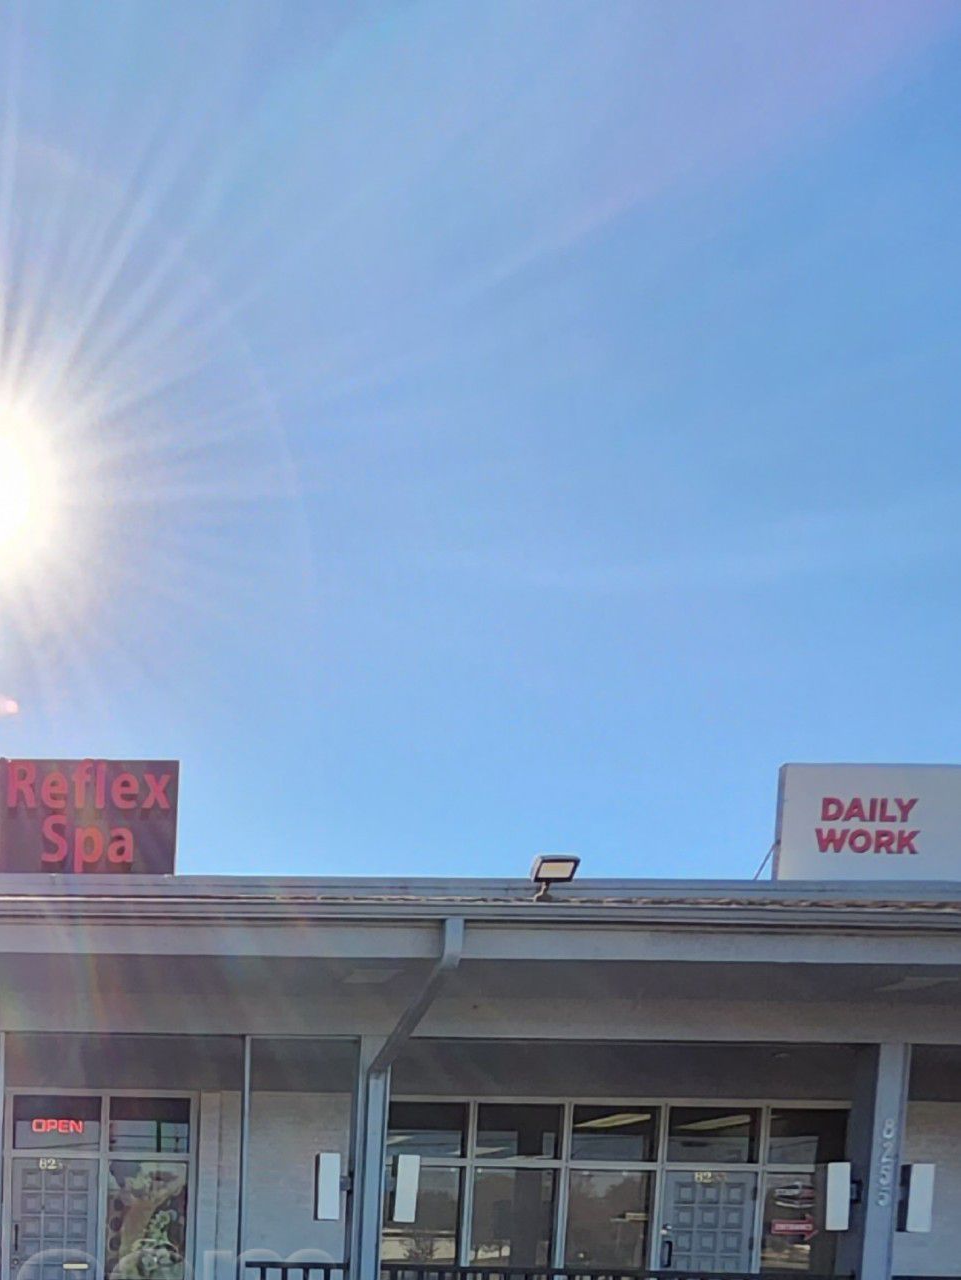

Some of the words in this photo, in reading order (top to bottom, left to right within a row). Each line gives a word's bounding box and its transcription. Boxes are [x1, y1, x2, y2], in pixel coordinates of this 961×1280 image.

[6, 759, 171, 810] Reflex
[821, 797, 920, 823] DAILY
[41, 814, 134, 874] Spa
[814, 827, 921, 854] WORK
[32, 1118, 83, 1133] OPEN
